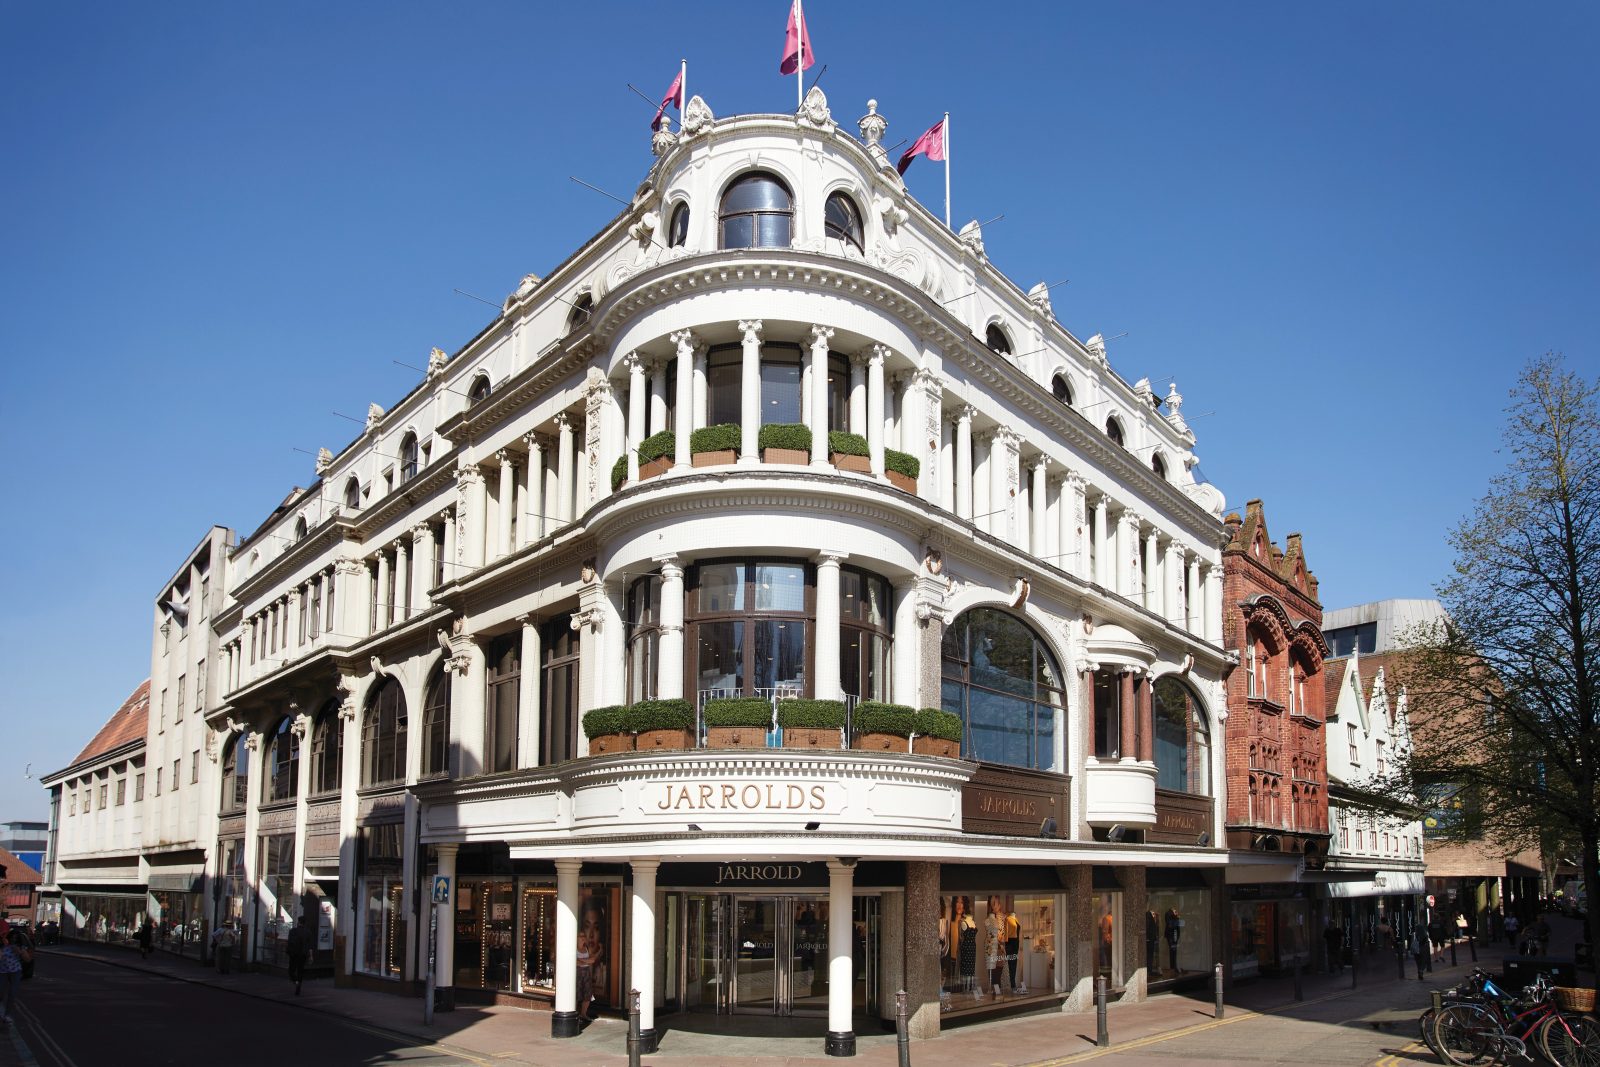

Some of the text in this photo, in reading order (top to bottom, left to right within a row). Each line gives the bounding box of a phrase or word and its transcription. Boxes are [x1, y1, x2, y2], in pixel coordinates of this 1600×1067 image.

[658, 784, 826, 810] JARROLDS
[980, 796, 1036, 816] JARROLDS
[715, 866, 801, 884] JARROLD
